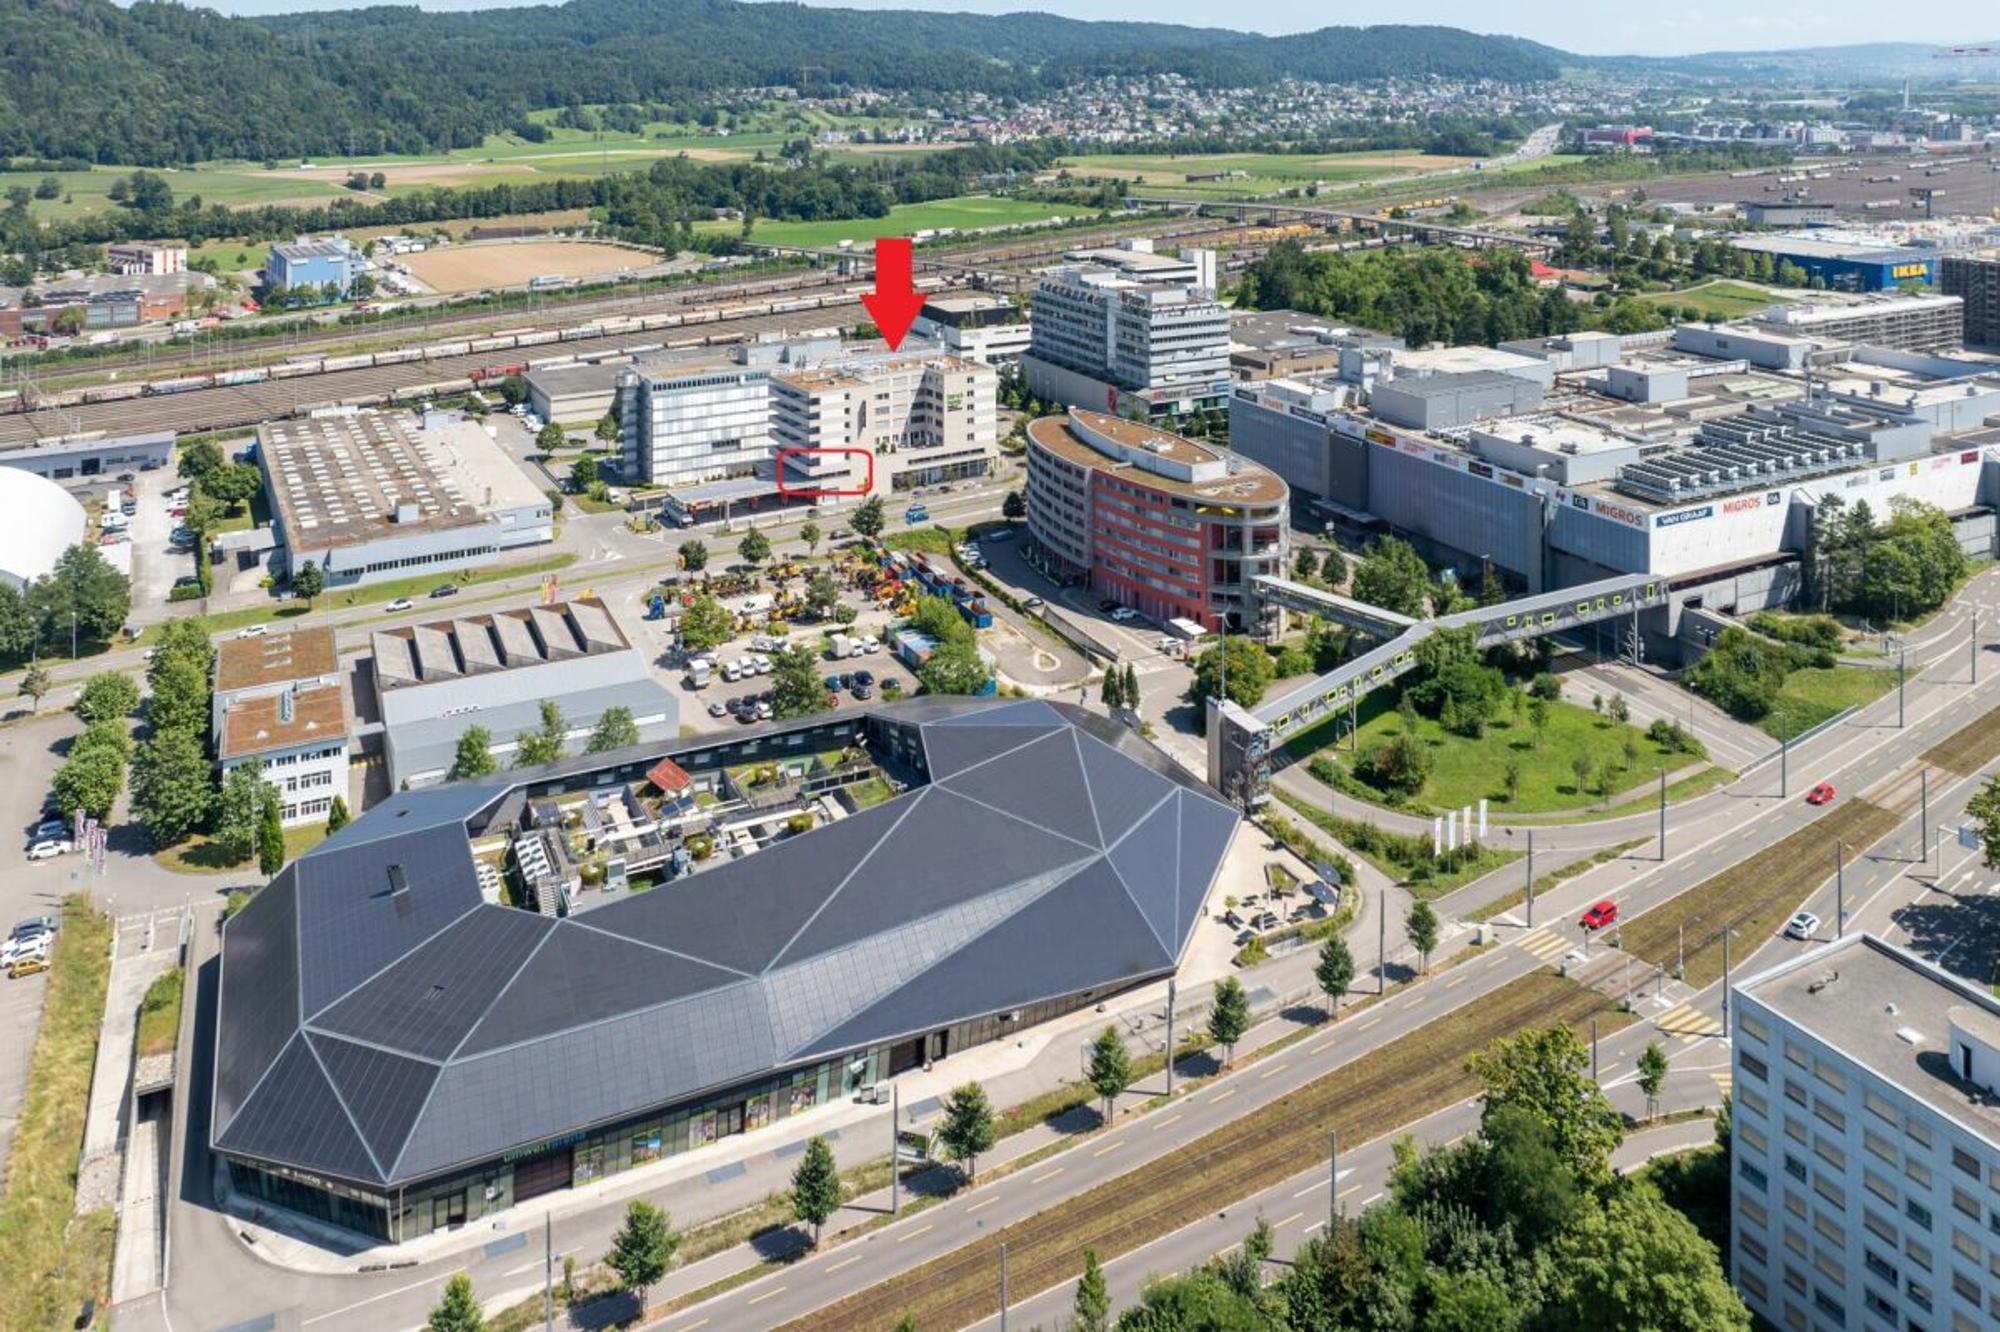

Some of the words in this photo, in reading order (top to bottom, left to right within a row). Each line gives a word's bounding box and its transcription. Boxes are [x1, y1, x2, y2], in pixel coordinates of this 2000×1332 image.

[1892, 263, 1927, 278] IKEA
[1723, 497, 1761, 514] MIGROS
[1595, 502, 1643, 527] MIGROS
